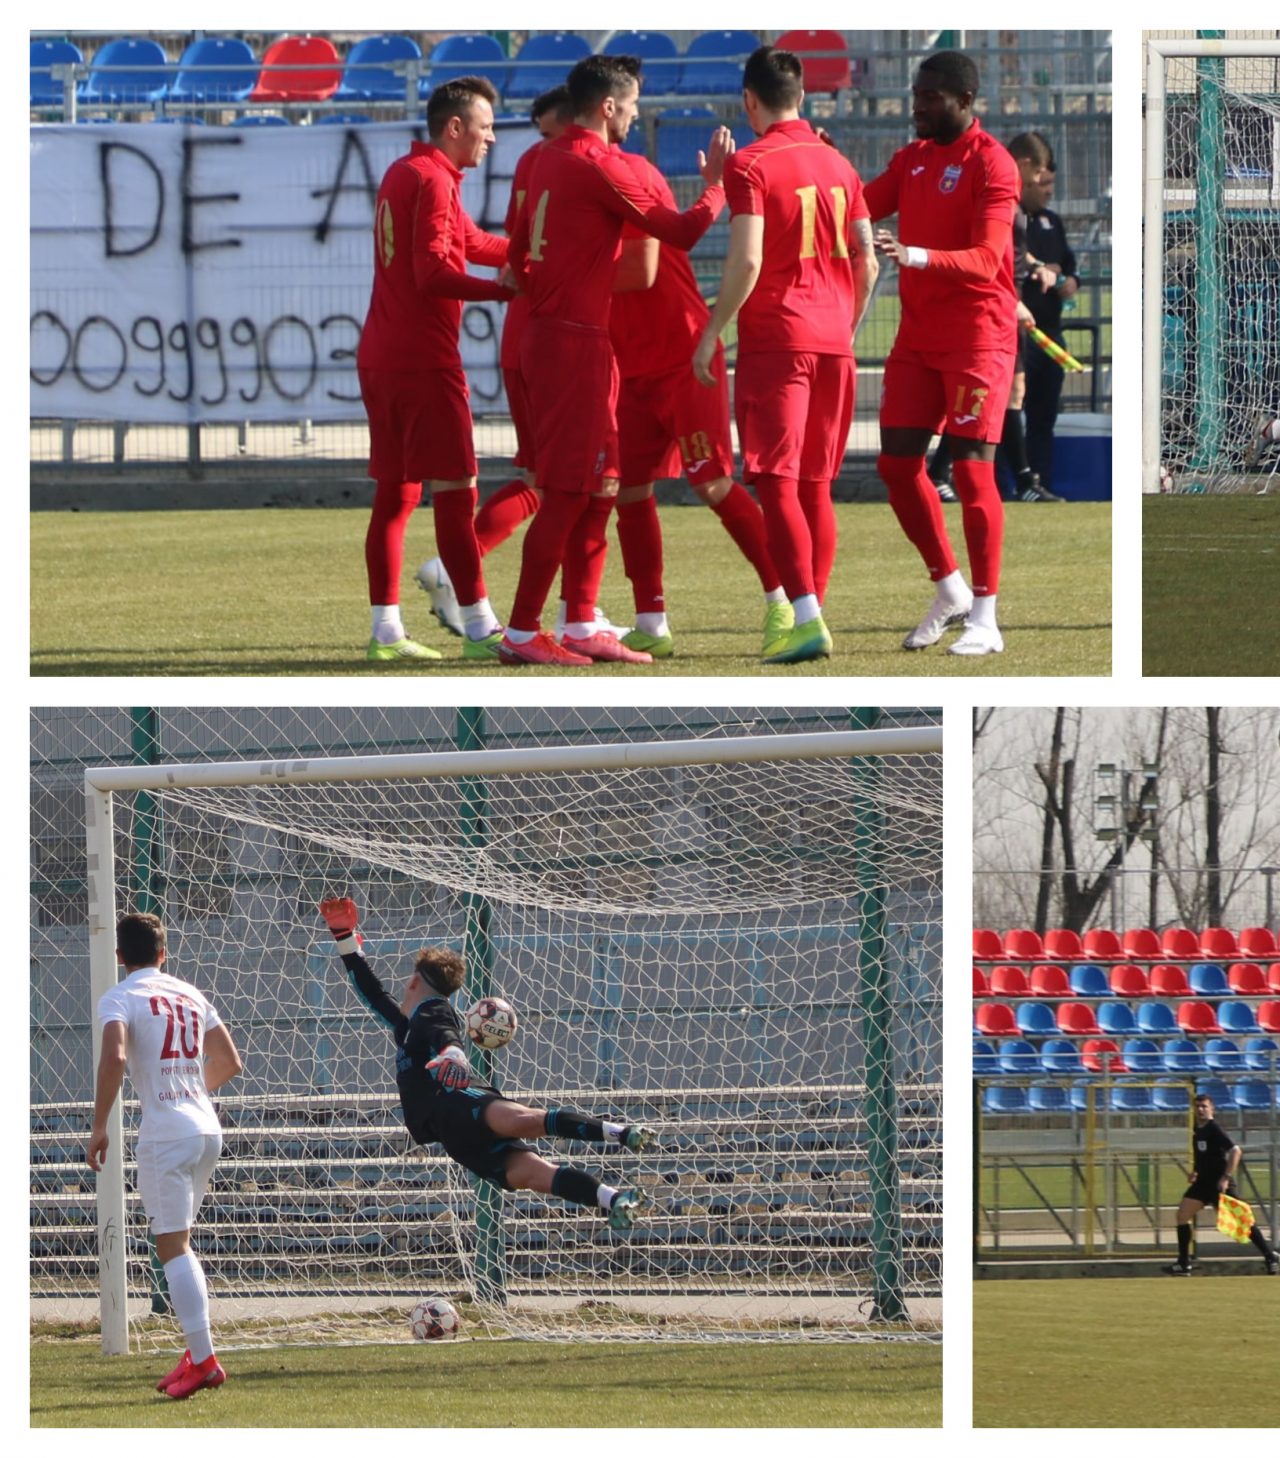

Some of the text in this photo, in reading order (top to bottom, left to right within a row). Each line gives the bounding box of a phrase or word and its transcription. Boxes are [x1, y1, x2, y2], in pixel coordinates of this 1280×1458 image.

[98, 135, 243, 258] DE
[795, 185, 849, 259] 11
[678, 431, 711, 463] 18
[149, 994, 199, 1060] 20
[484, 1024, 510, 1038] SELECT
